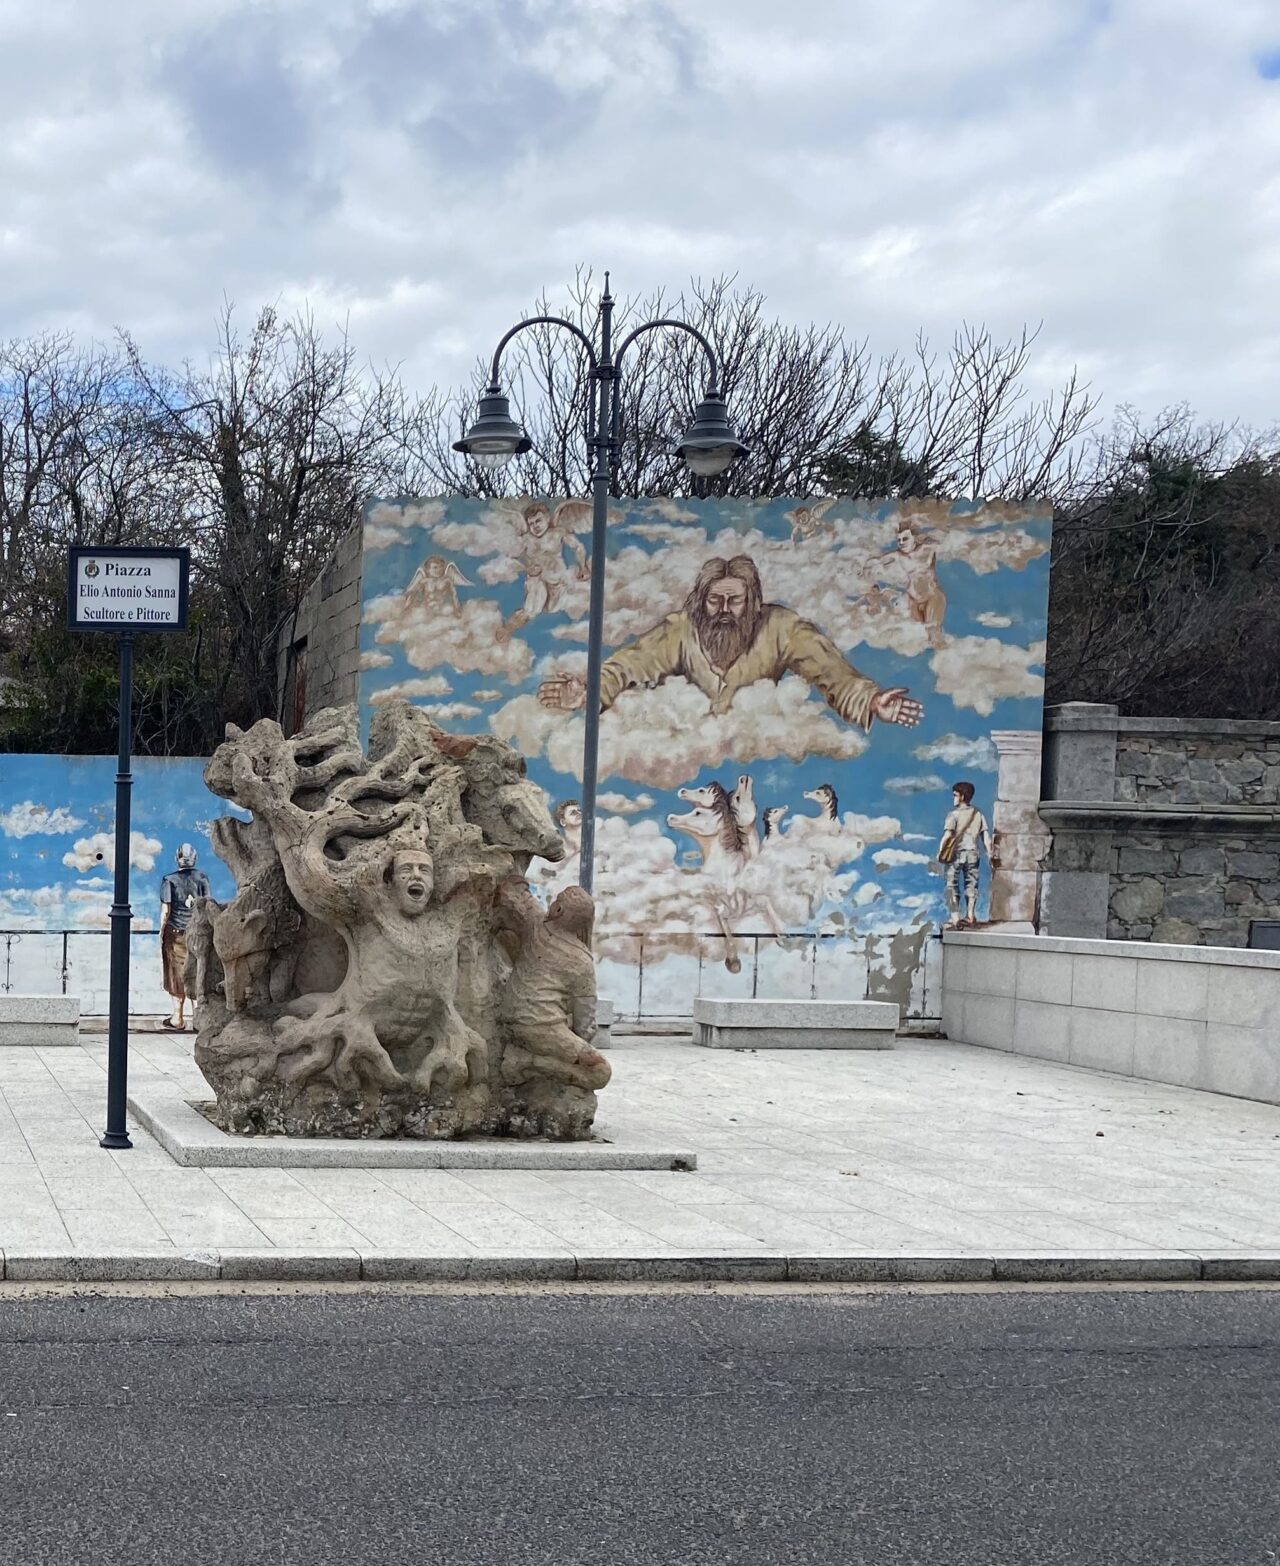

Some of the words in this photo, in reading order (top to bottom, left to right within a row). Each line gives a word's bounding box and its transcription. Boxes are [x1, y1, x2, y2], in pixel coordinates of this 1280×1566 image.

[105, 563, 151, 576] Piazza
[80, 584, 99, 597] Elio
[102, 585, 142, 598] Antonio
[145, 585, 176, 599] Sanna
[84, 606, 125, 620] Scultore
[128, 612, 134, 620] e
[136, 607, 171, 620] Pittore
